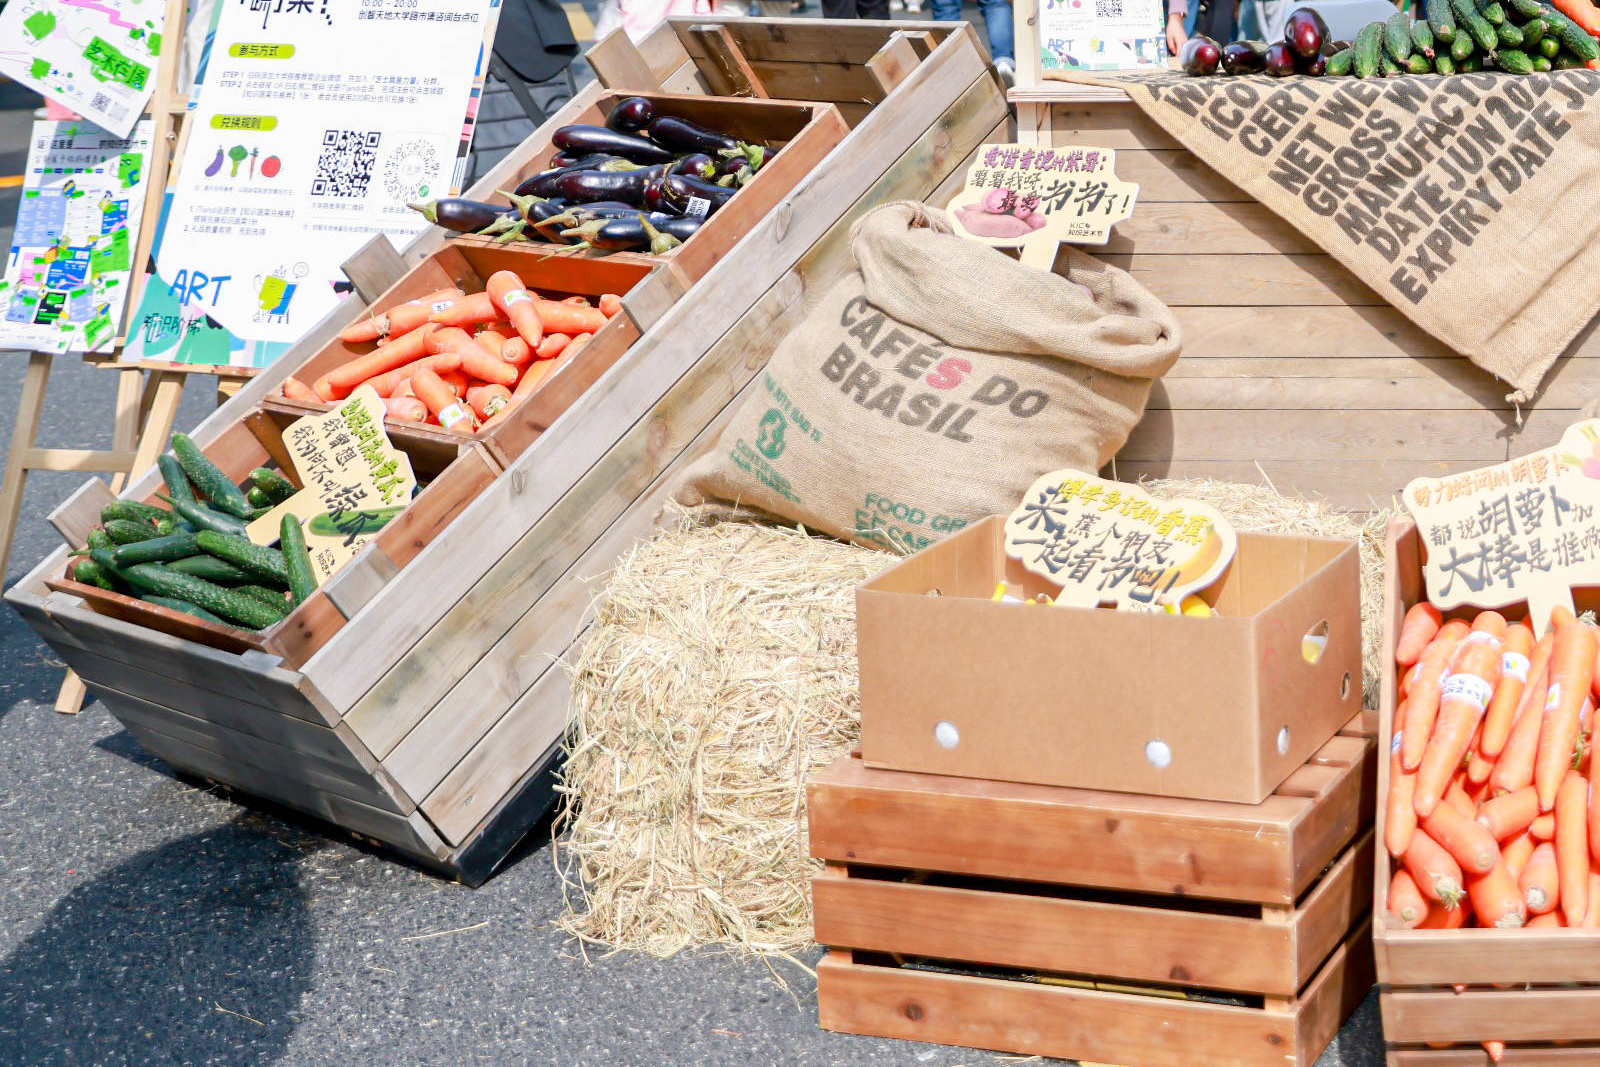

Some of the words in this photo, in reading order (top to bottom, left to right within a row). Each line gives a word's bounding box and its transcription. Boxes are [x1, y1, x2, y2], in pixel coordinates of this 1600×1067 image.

[1267, 138, 1336, 196] NET
[1303, 108, 1403, 217] GROSS
[1335, 73, 1499, 245] MANUFACTU
[1367, 174, 1454, 263] DATE
[1447, 113, 1502, 190] JUN
[1390, 178, 1503, 305] EXPIRY
[1488, 100, 1573, 194] DATE
[168, 268, 232, 307] ART
[819, 342, 976, 444] BRASIL
[970, 374, 1050, 420] DO
[864, 493, 927, 526] FOOD
